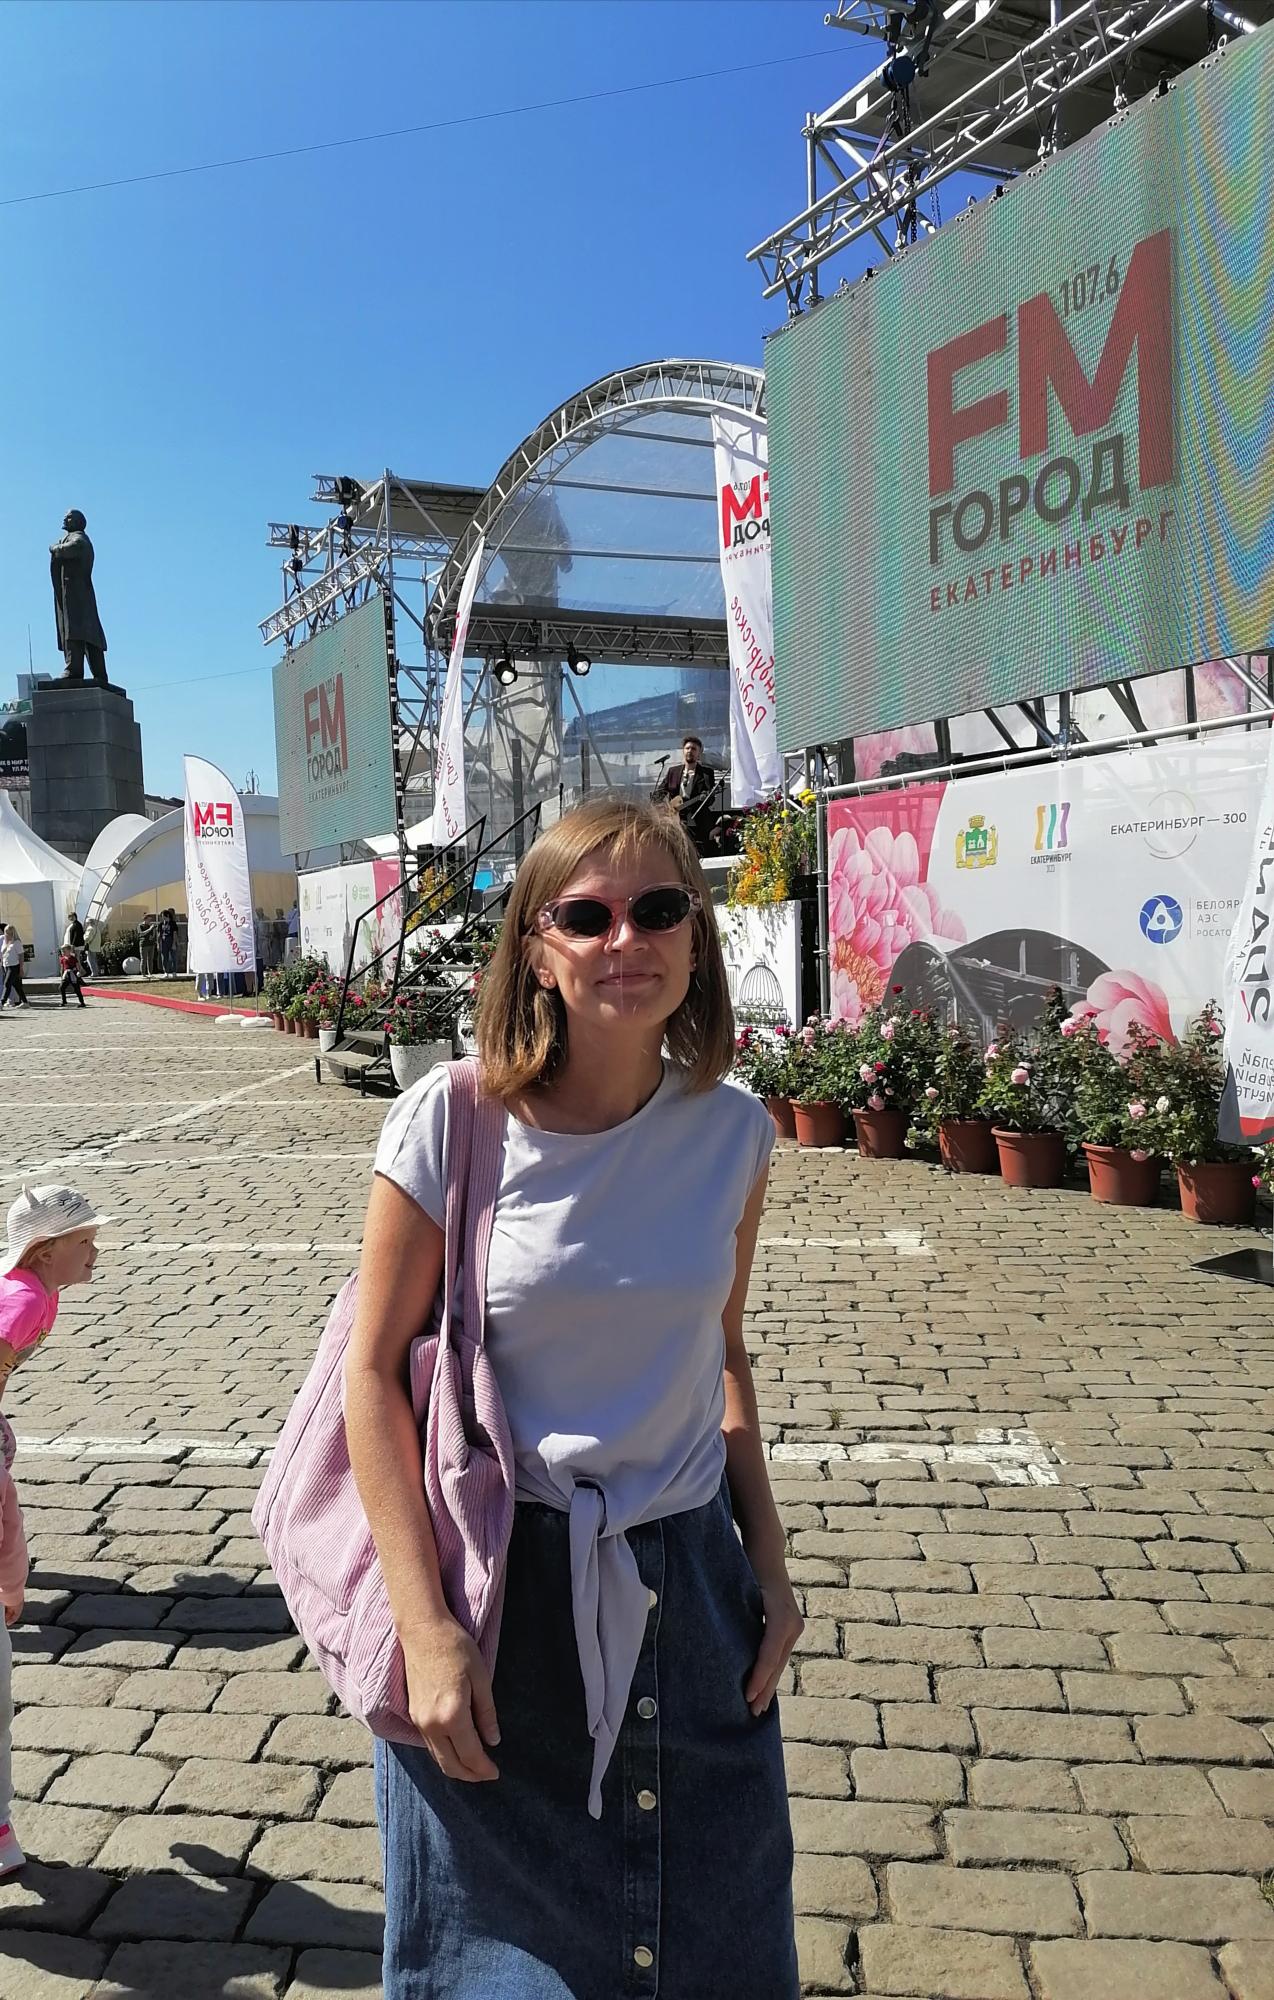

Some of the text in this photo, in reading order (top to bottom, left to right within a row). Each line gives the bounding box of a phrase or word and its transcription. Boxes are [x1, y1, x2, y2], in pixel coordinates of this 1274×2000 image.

[927, 228, 1173, 497] FM
[929, 433, 1130, 564] ГОРОД
[931, 511, 1174, 612] ЕКАТЕРИНБУРГ
[304, 672, 348, 770] FM
[308, 747, 343, 783] ГОРОД
[1110, 816, 1206, 835] ЕКАТЕРИНБУРГ
[1223, 812, 1248, 824] 300
[1030, 852, 1073, 865] ЕКАТЕРИНБУРГ
[1196, 899, 1240, 910] БЕЛОЯР
[1197, 913, 1220, 923] АЭС
[1196, 928, 1232, 937] РОСАТО
